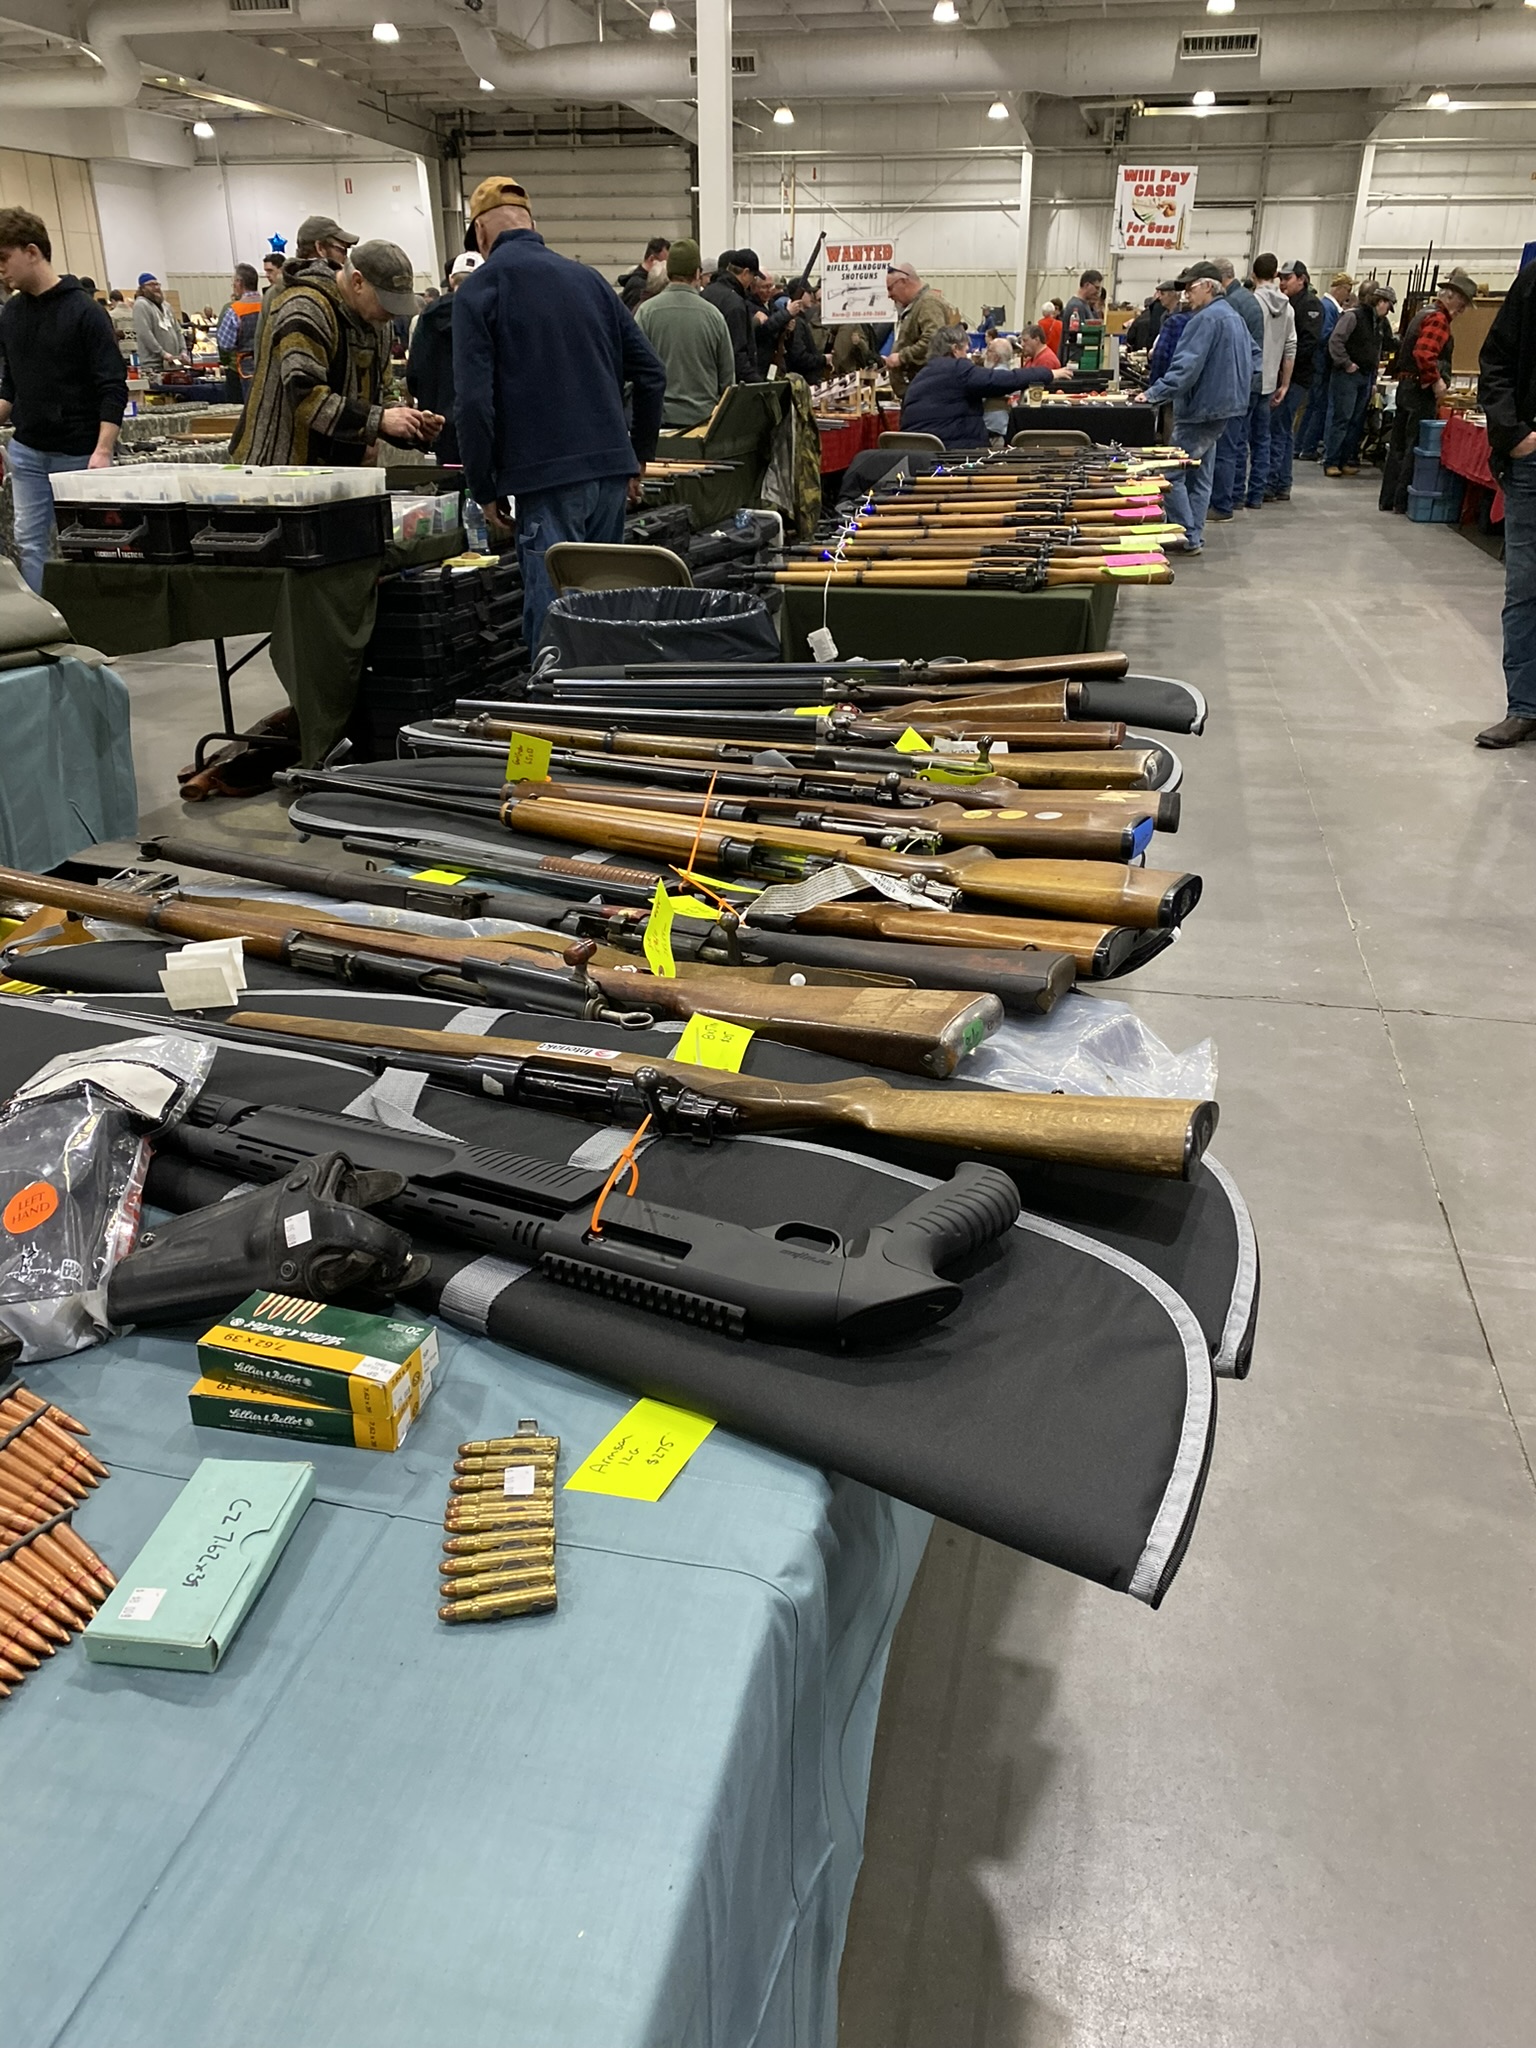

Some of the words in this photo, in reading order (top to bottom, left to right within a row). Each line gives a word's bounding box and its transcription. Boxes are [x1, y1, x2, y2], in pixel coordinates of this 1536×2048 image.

[1124, 169, 1155, 182] Will
[1160, 169, 1190, 185] Pay
[1134, 184, 1176, 197] CASH
[1126, 221, 1145, 233] For
[1147, 221, 1175, 234] Guns
[1126, 235, 1135, 247] &
[1137, 235, 1173, 247] Ammo
[826, 244, 893, 263] WANTED
[826, 264, 851, 272] RIFLES,
[853, 262, 891, 270] HANDGUNS
[841, 272, 878, 280] SHOTGUNS
[18, 1191, 46, 1211] LEFT
[12, 1202, 51, 1224] HAND
[405, 1326, 425, 1336] 20
[224, 1333, 243, 1343] 39
[255, 1339, 286, 1352] 7,62
[234, 1362, 264, 1377] Sellier
[271, 1370, 302, 1385] Bellot
[229, 1408, 262, 1421] Sellier
[270, 1413, 303, 1426] Bellot
[222, 1498, 252, 1525] CZ
